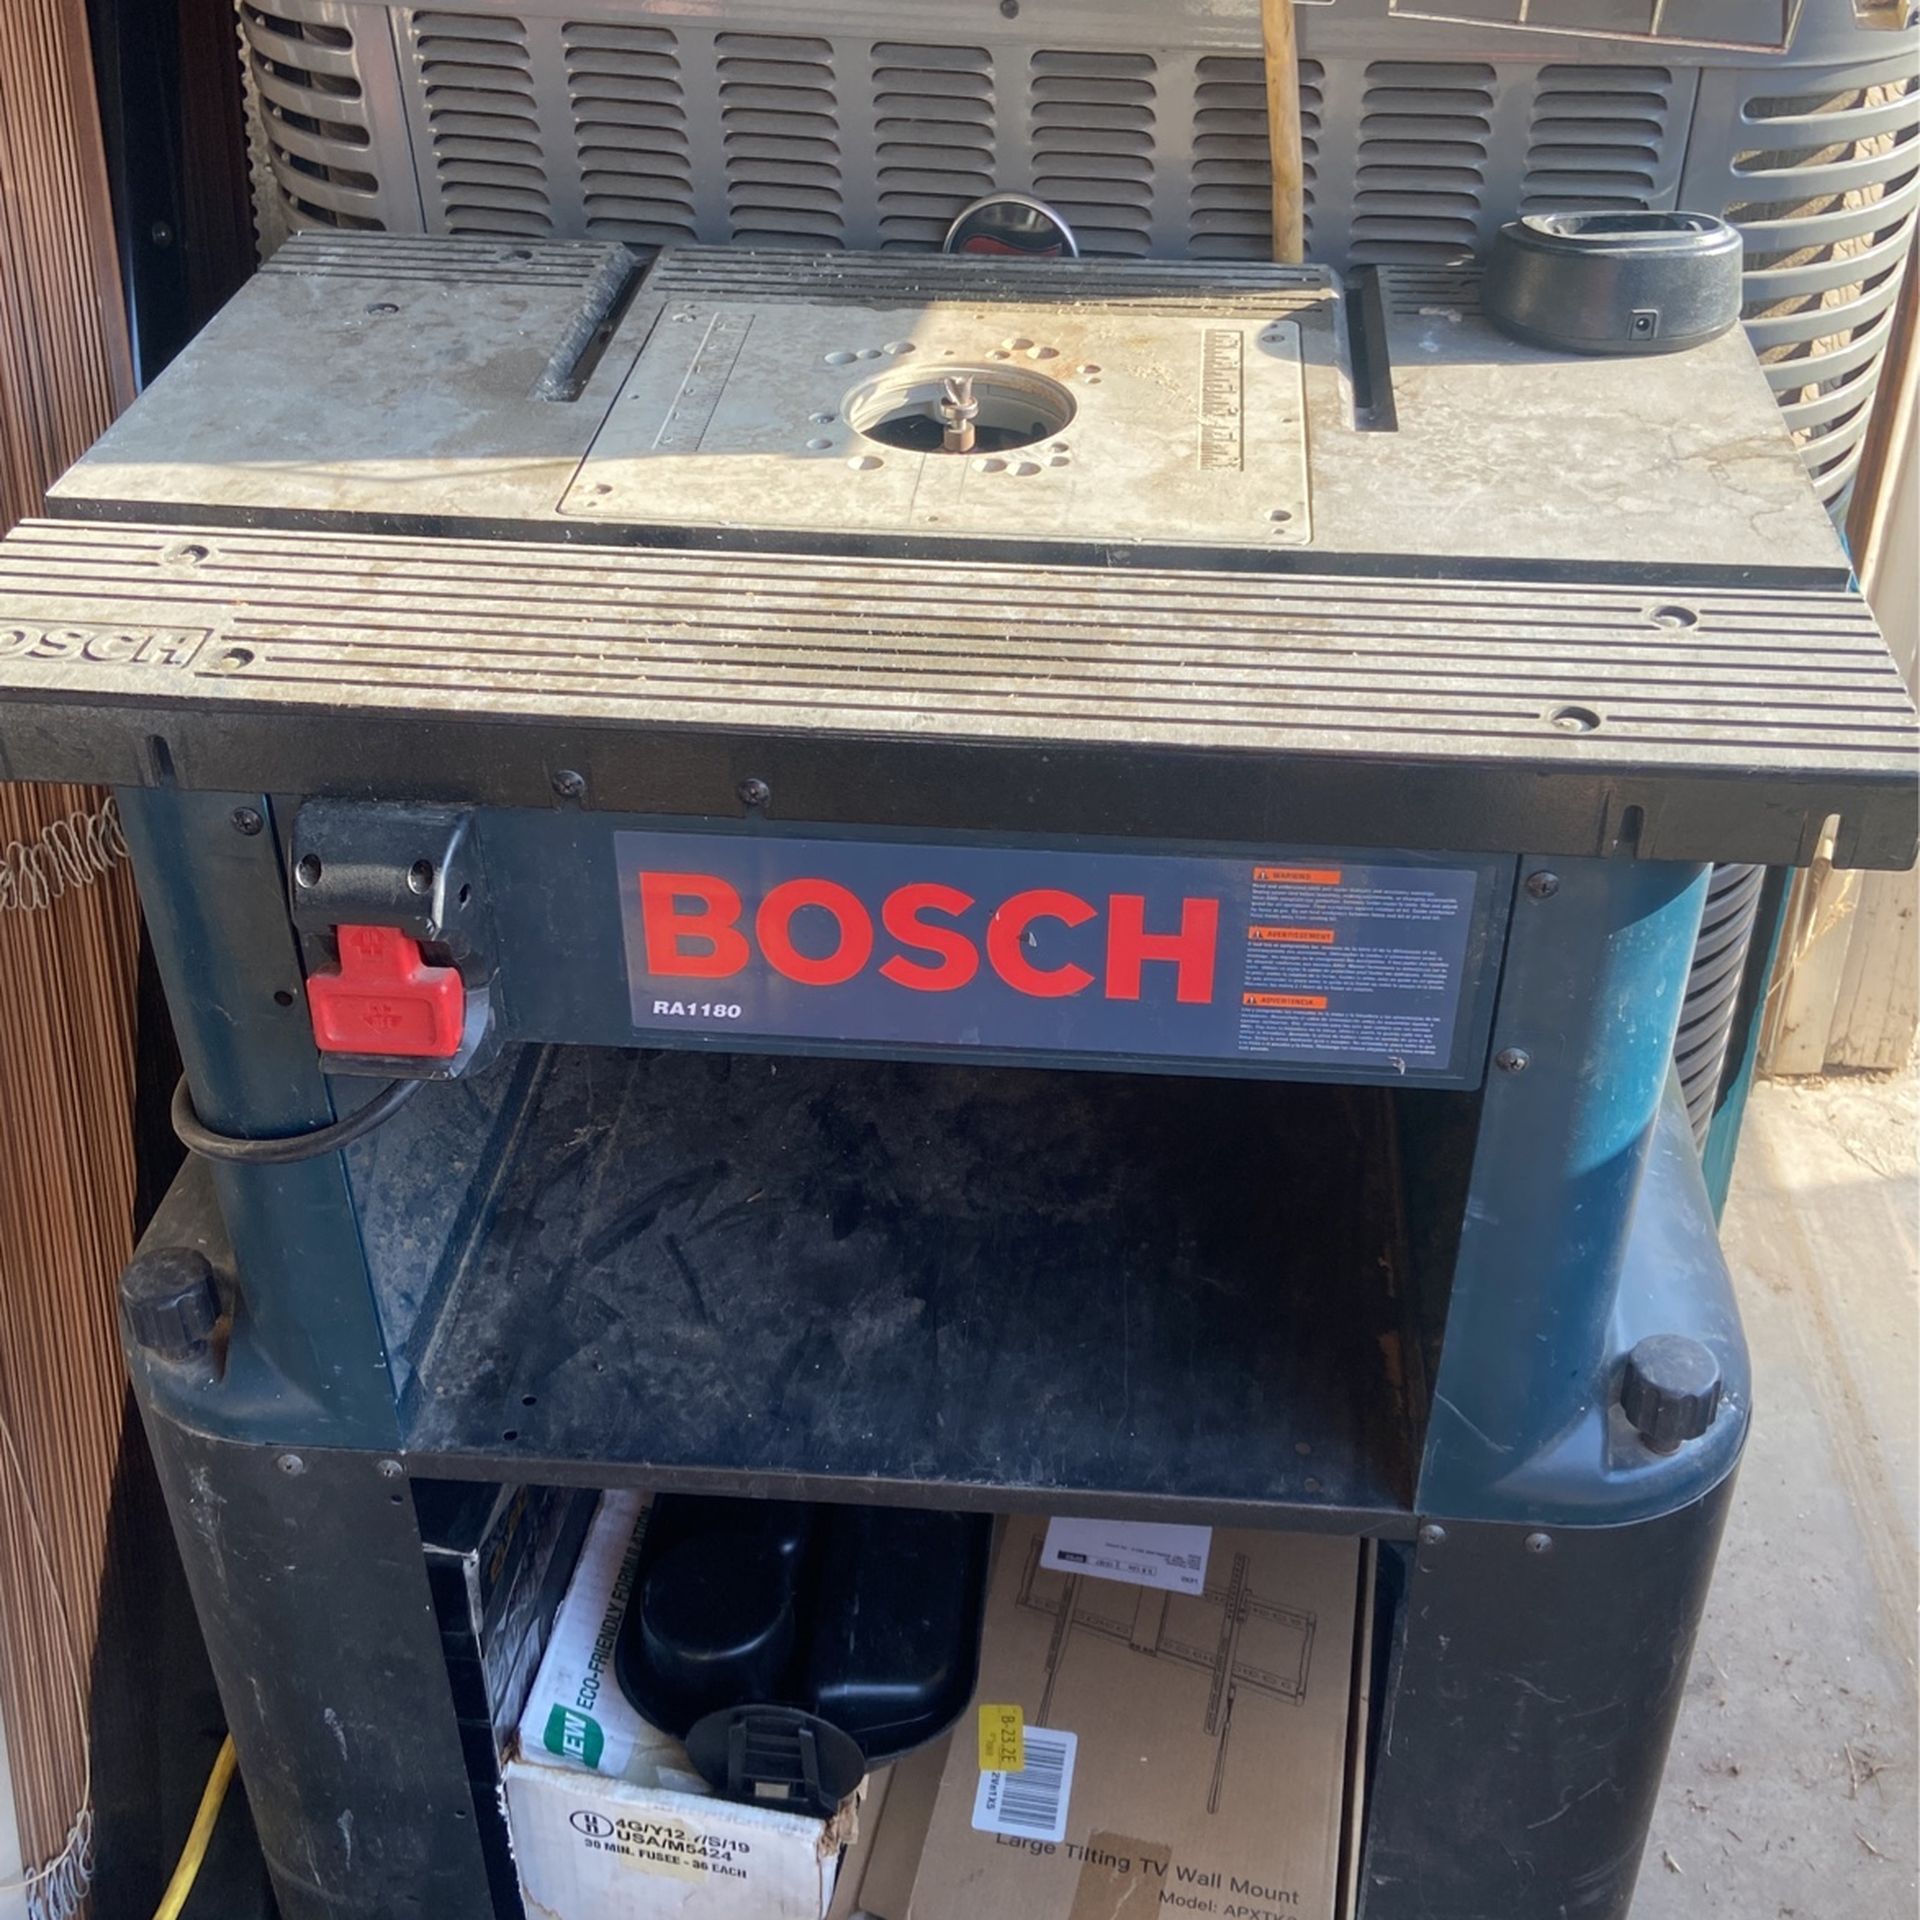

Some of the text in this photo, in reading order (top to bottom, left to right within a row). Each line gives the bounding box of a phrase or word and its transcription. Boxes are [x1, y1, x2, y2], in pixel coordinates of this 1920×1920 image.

[0, 625, 193, 665] OSCH
[639, 871, 1219, 1004] BOSCH
[653, 1000, 742, 1019] RA1180
[576, 1601, 624, 1711] ECO-FRIENDLY
[585, 1838, 601, 1850] 30
[604, 1842, 635, 1857] MIN.
[639, 1849, 680, 1866] FUSEE
[712, 1864, 748, 1879] EACH
[617, 1829, 733, 1863] USA/M5424
[996, 1833, 1300, 1905] Large Tilting TV Wall Mount
[1159, 1889, 1218, 1912] Model:
